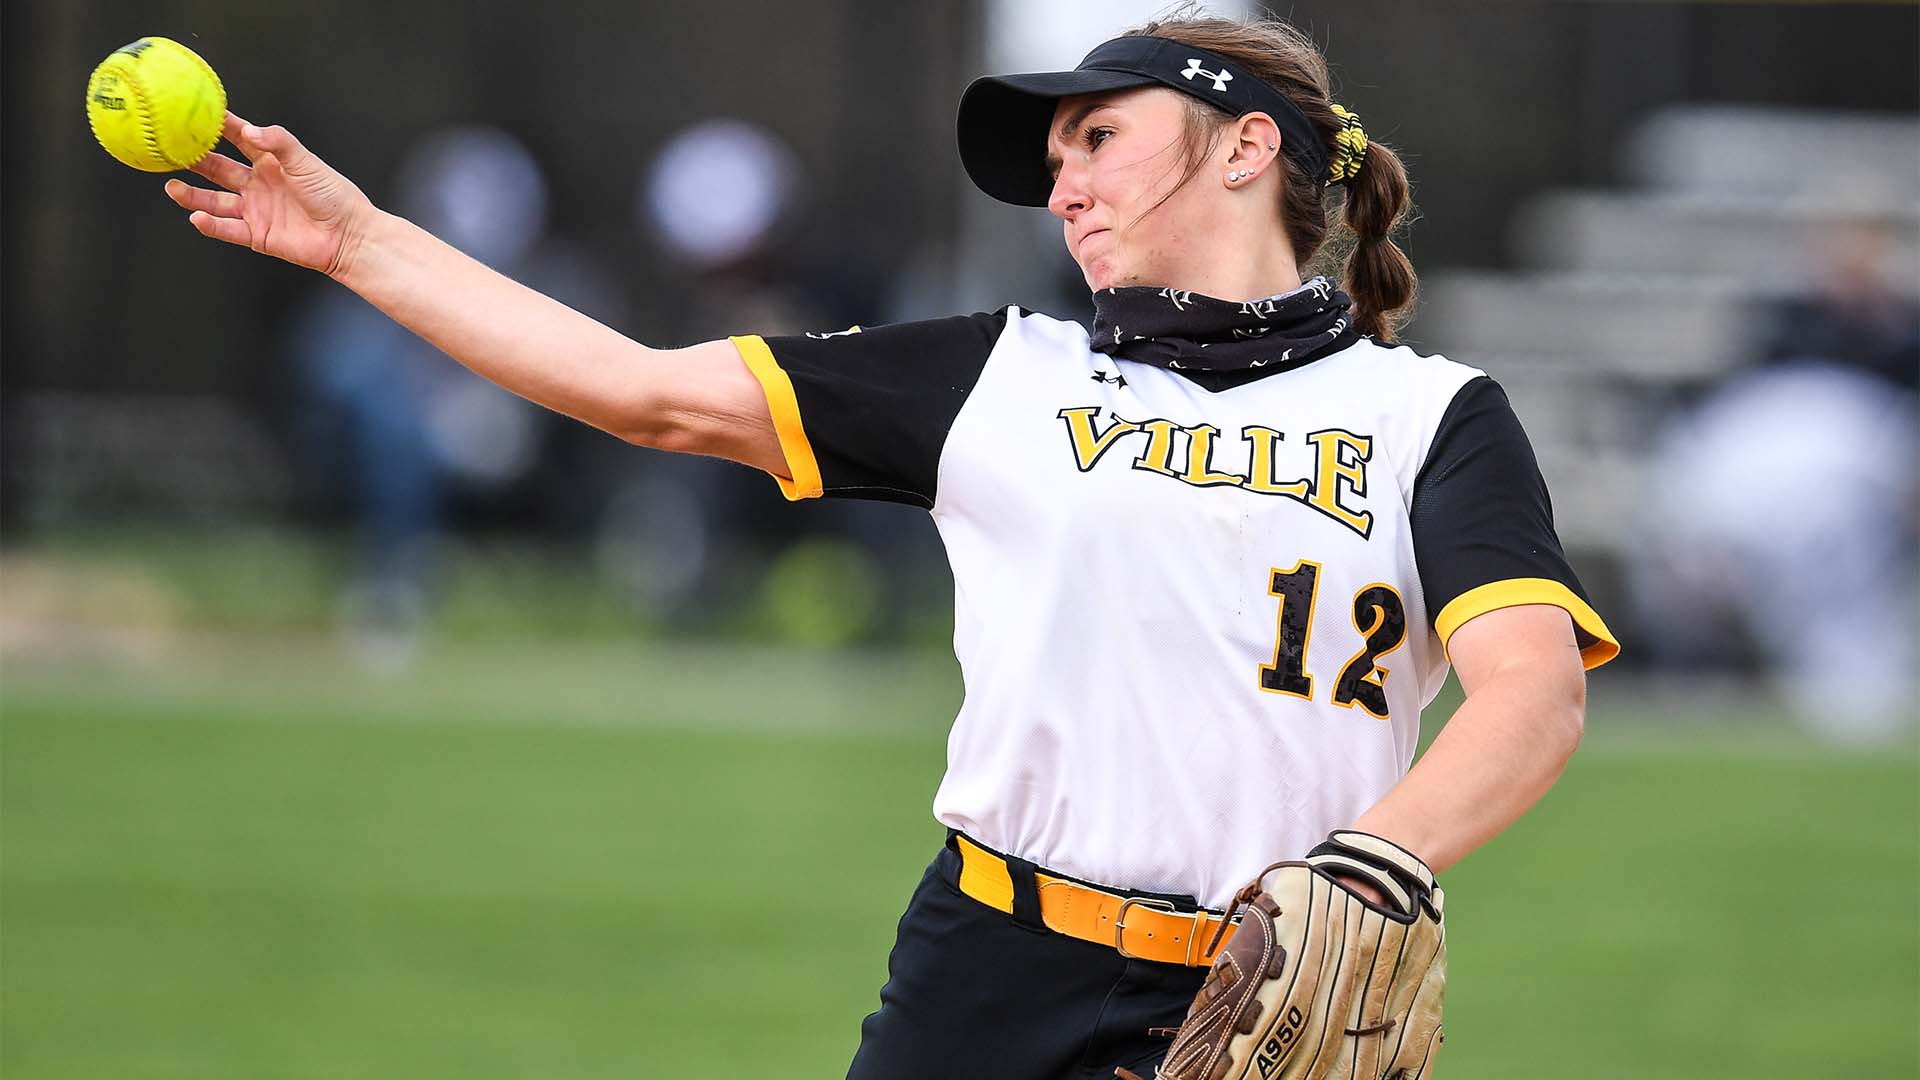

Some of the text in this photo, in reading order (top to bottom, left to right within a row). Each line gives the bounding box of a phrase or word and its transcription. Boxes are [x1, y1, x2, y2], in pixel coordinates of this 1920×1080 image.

[1057, 406, 1374, 541] VILLE
[1258, 558, 1408, 720] 12
[1256, 1005, 1303, 1080] A950
